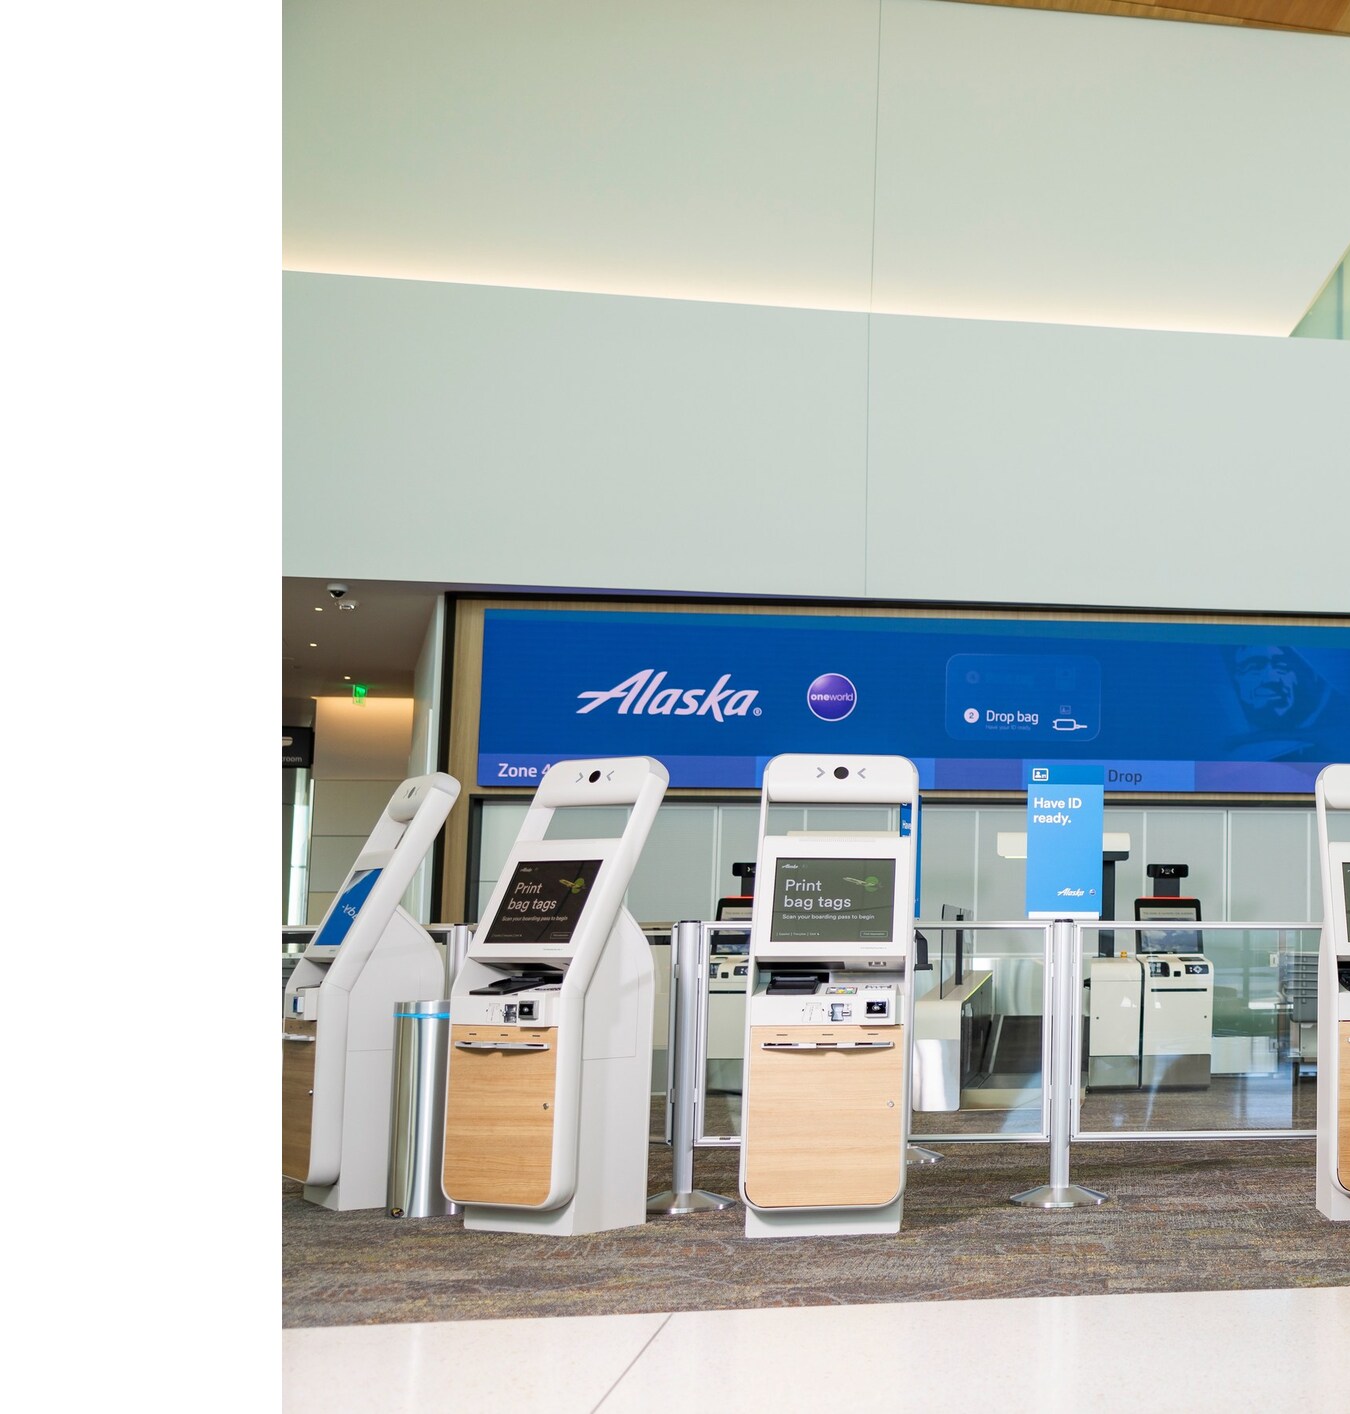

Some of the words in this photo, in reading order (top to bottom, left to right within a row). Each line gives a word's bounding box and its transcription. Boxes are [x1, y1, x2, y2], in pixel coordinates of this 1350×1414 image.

[810, 692, 854, 702] oneworld
[986, 709, 1014, 724] Drop
[1017, 710, 1039, 725] bag
[282, 755, 303, 763] room
[498, 762, 538, 778] Zone
[1108, 769, 1143, 785] Drop
[1033, 797, 1066, 809] Have
[1068, 797, 1082, 809] ID
[1033, 812, 1072, 826] ready.
[514, 881, 543, 894] Print
[785, 879, 822, 891] Print
[507, 898, 530, 913] bag
[532, 899, 557, 912] tags
[784, 895, 814, 910] bag
[818, 896, 852, 910] tags
[811, 913, 837, 921] boarding
[858, 913, 875, 921] begin
